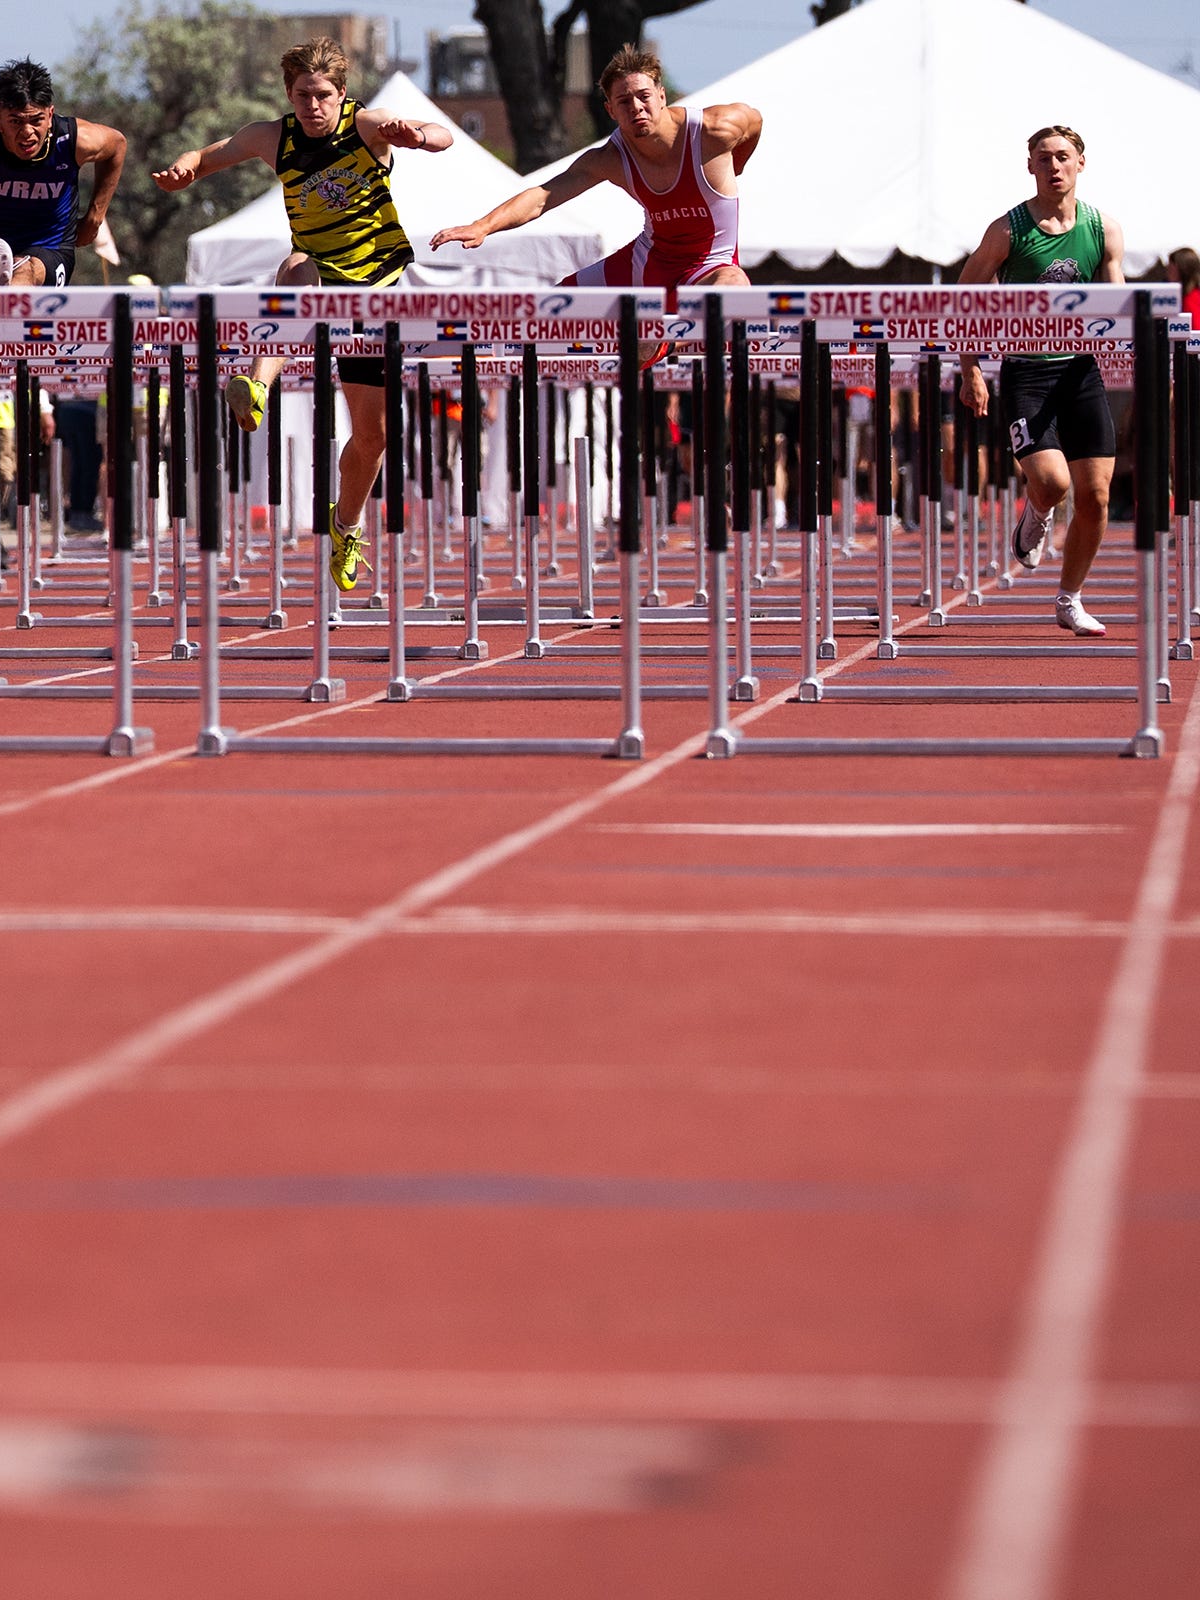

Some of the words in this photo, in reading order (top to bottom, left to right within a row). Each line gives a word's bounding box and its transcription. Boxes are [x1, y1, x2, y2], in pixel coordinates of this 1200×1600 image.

[651, 206, 708, 222] IGNACIO
[300, 294, 361, 317] STATE
[369, 294, 536, 317] CHAMPIONSHIPS
[809, 292, 872, 315] STATE
[879, 292, 1050, 314] CHAMPIONSHIPS
[57, 321, 107, 342] STATE
[470, 320, 520, 341] STATE
[887, 318, 938, 339] STATE
[944, 317, 1084, 338] CHAMPIONSHIPS
[242, 343, 285, 355] STATE
[948, 340, 991, 352] STATE
[997, 339, 1116, 352] CHAMPIONSHIPS
[475, 361, 507, 373] STATE
[749, 359, 781, 371] STATE
[1012, 421, 1024, 449] 3
